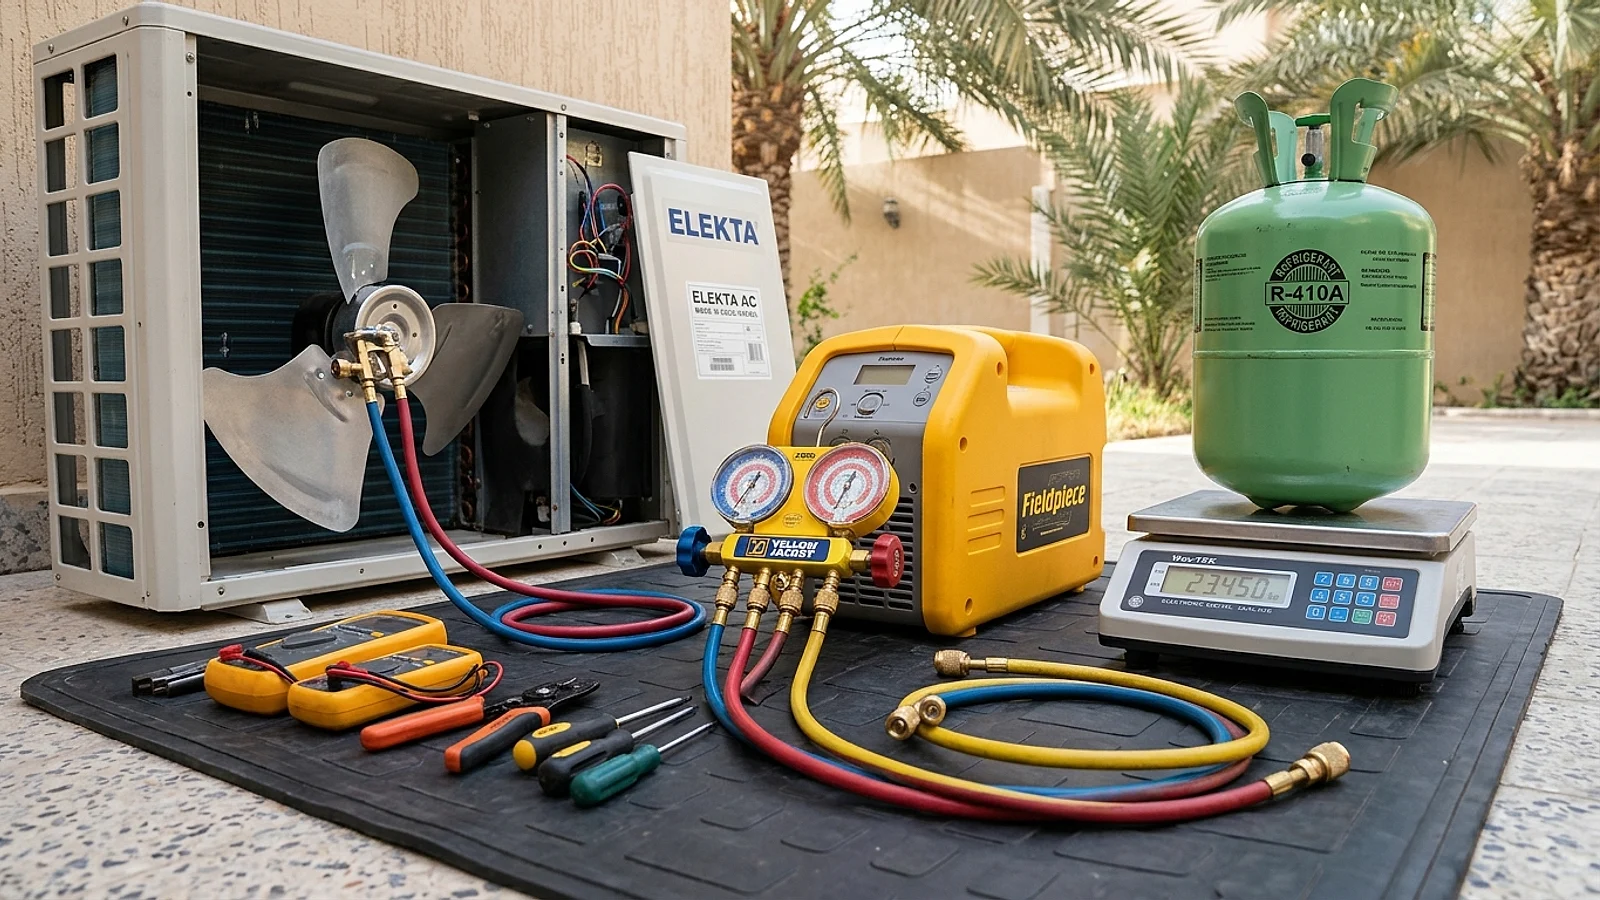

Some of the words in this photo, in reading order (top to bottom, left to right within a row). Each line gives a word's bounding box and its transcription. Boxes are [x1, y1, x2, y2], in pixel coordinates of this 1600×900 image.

[668, 208, 759, 245] ELEKTA
[692, 290, 738, 307] ELEKTA
[741, 295, 757, 308] AC
[1271, 285, 1344, 301] R-410A
[1022, 484, 1086, 518] Fieldpiece
